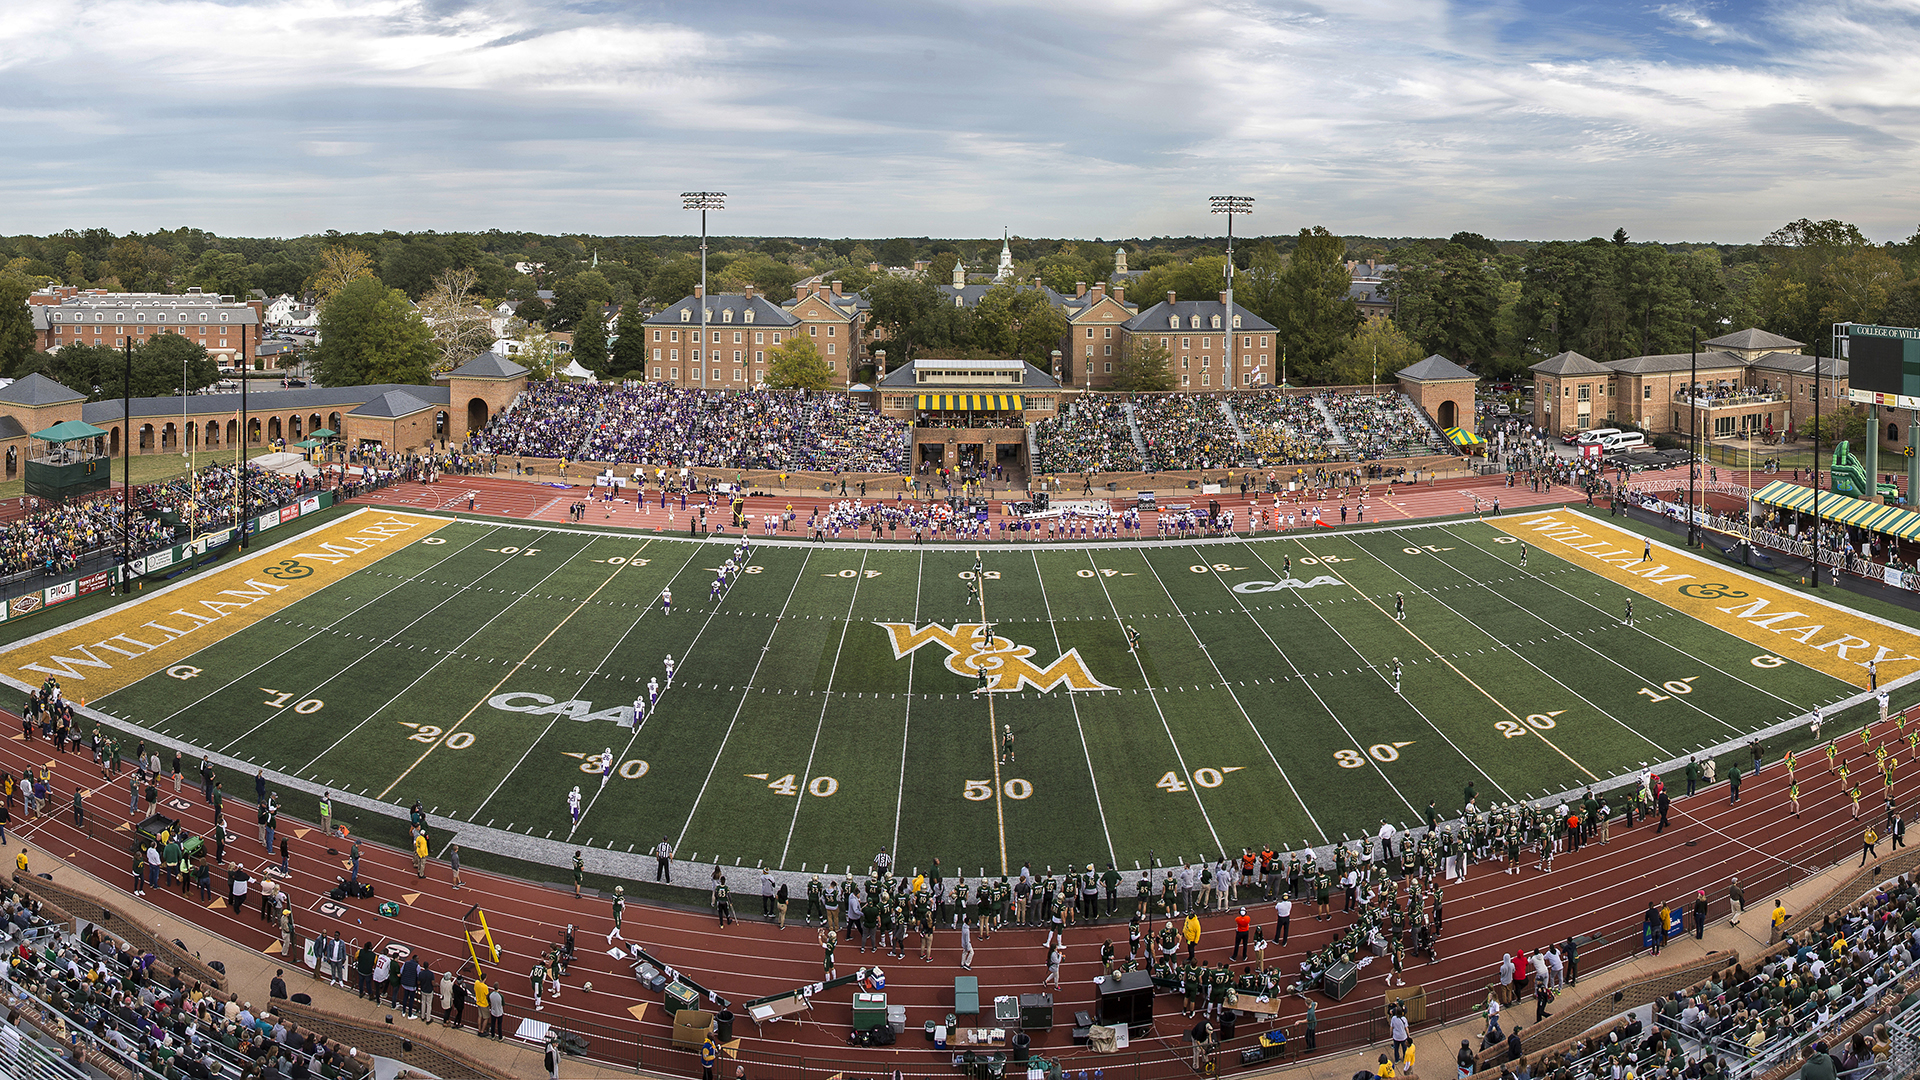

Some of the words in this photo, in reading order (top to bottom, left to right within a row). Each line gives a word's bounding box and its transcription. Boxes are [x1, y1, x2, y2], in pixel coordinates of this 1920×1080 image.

[1857, 326, 1888, 337] COLLEGE
[1888, 328, 1898, 338] OF
[50, 583, 72, 598] PIVOT
[1232, 575, 1345, 594] CAA
[1518, 515, 1698, 586] WILLIAM
[1678, 583, 1749, 600] &
[1715, 596, 1920, 670] MARY
[18, 578, 289, 680] WILLIAM
[262, 559, 314, 580] &
[302, 516, 419, 565] MARY
[166, 664, 203, 680] G
[1750, 653, 1788, 669] G
[1637, 679, 1693, 703] 10
[264, 692, 325, 715] 10
[487, 692, 635, 728] CAA
[407, 725, 476, 749] 20
[1494, 713, 1557, 739] 20
[579, 754, 650, 779] 30
[1333, 743, 1400, 769] 30
[767, 773, 839, 798] 40
[963, 778, 1034, 801] 50
[1155, 767, 1224, 793] 40
[376, 961, 384, 969] 31
[533, 968, 543, 976] 80
[1215, 975, 1225, 984] 67
